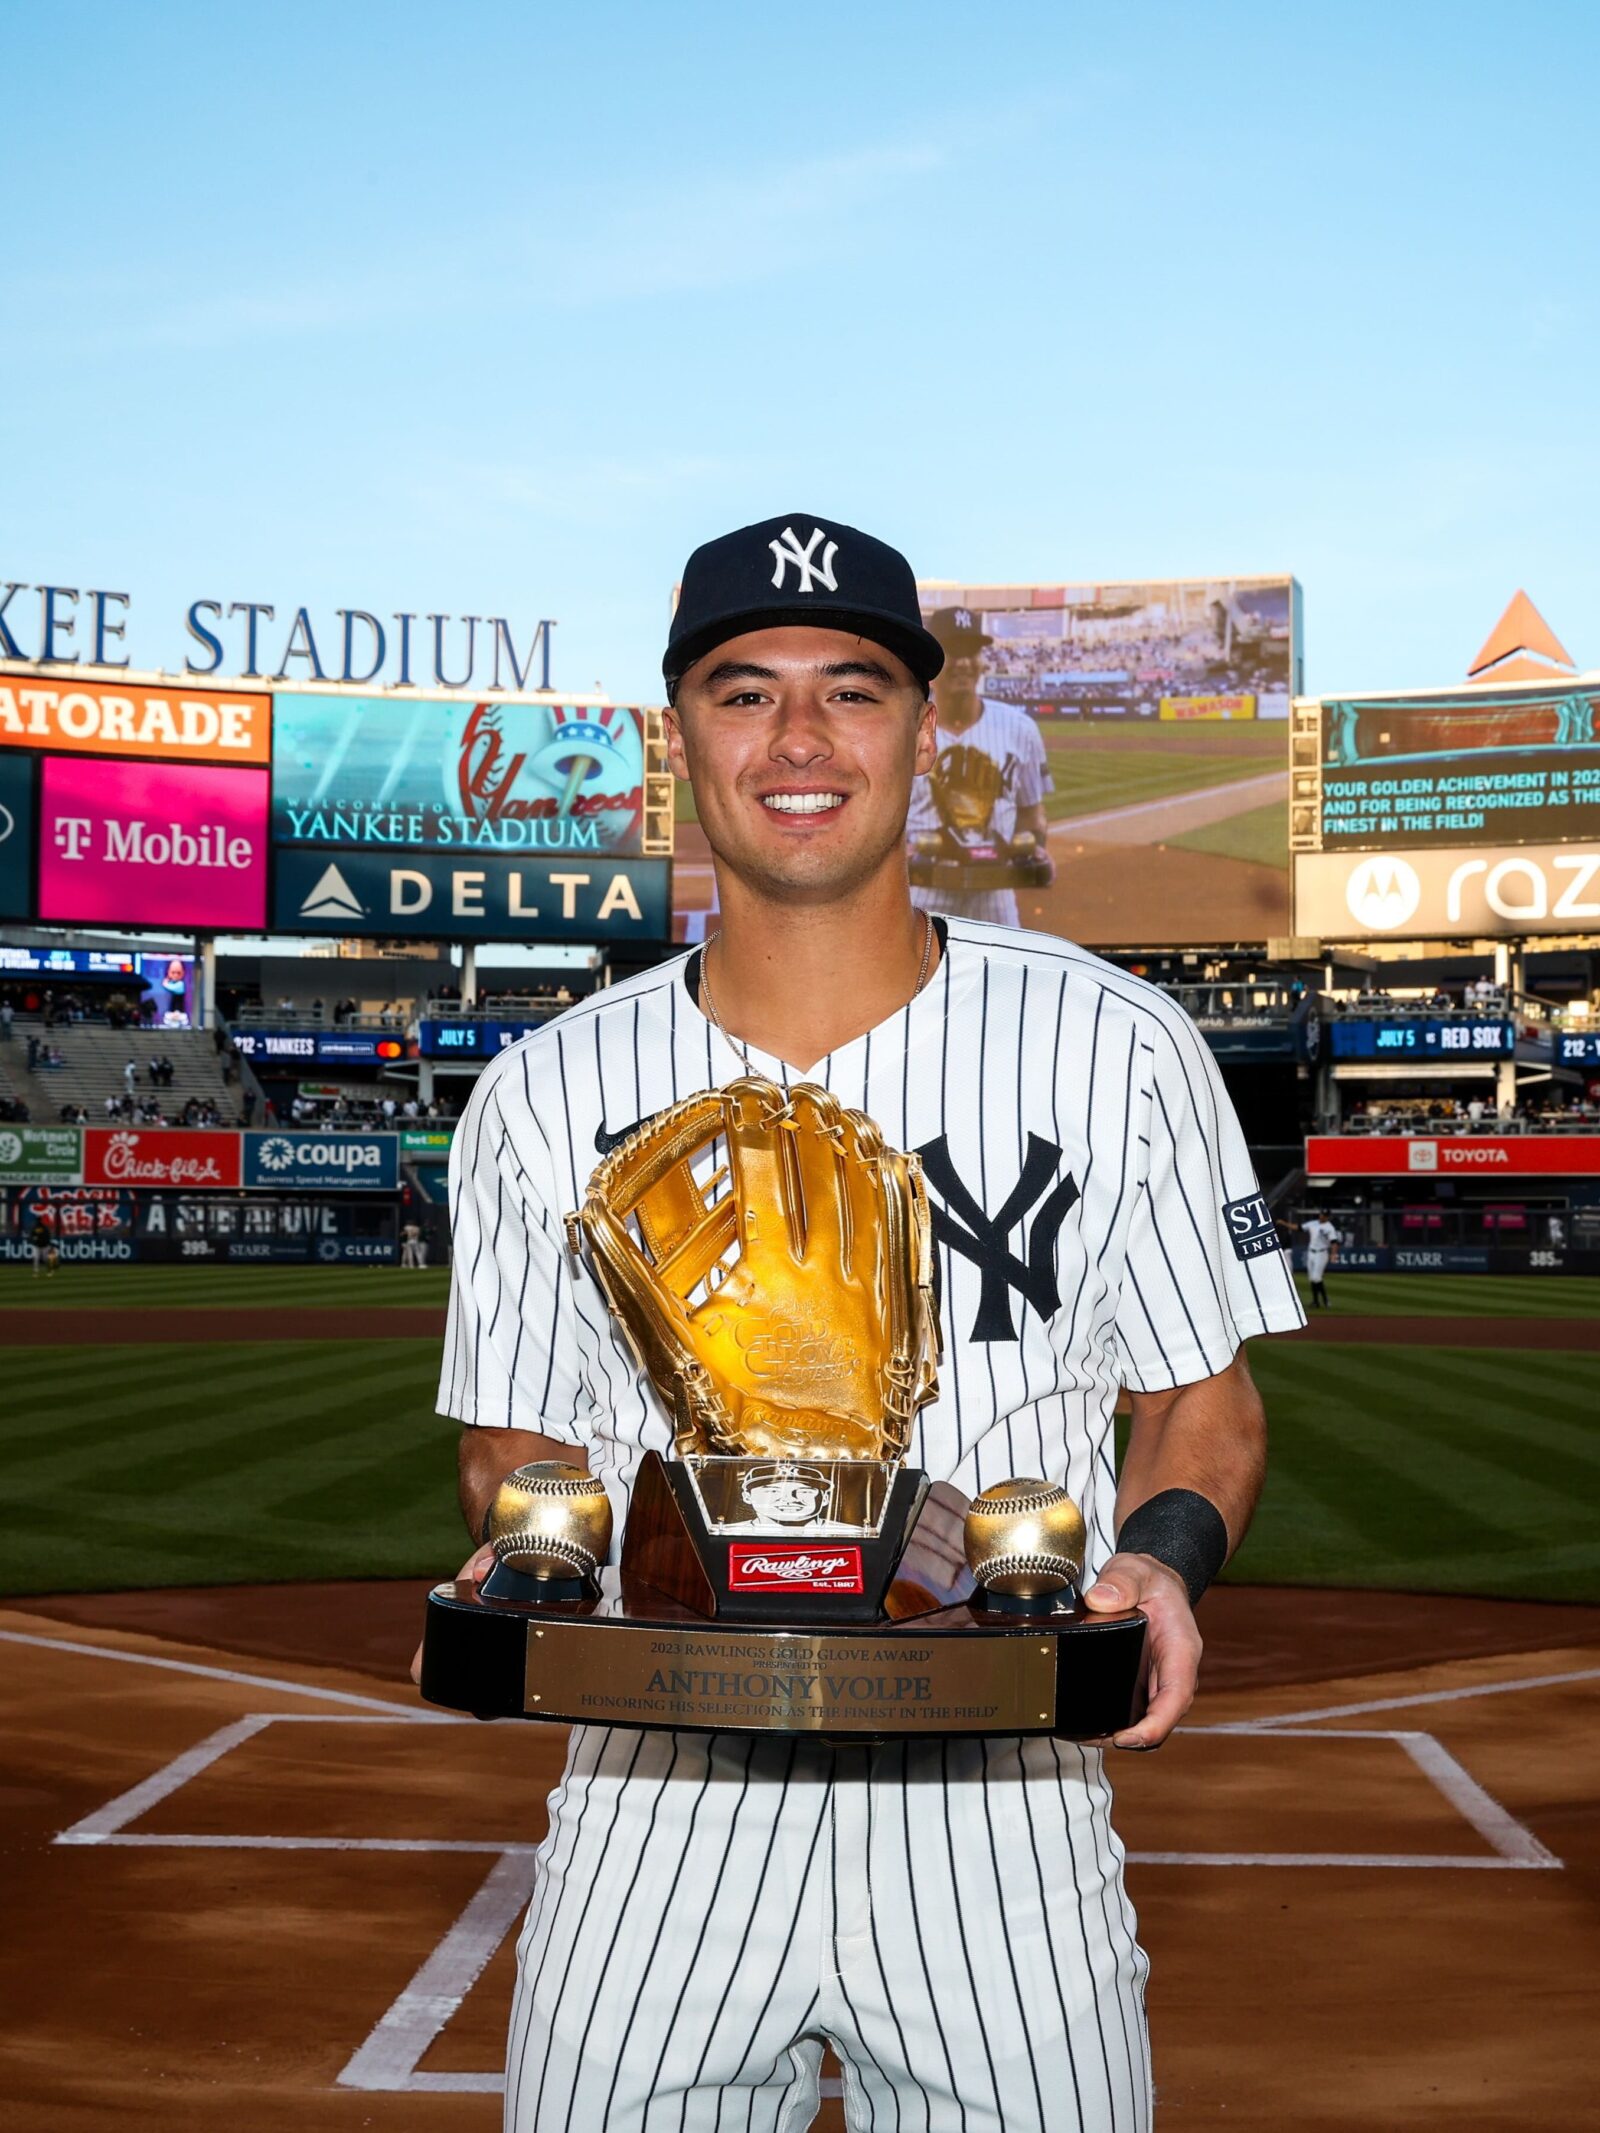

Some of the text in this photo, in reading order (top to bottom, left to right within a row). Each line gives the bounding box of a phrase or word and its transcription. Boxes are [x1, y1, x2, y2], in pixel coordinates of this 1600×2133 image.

[768, 526, 839, 592] NY
[184, 600, 557, 692] STADIUM
[1323, 782, 1367, 797] YOUR
[1370, 778, 1433, 796] GOLDEN
[1436, 772, 1548, 792] ACHIEVEMENT
[1551, 771, 1569, 787] IN
[287, 797, 444, 814] WELCOME TO
[1323, 800, 1357, 816] AND
[1360, 798, 1391, 814] FOR
[1395, 796, 1441, 813] BEING
[1445, 791, 1545, 810] RECOGNIZED
[1548, 790, 1570, 806] AS
[286, 810, 601, 848] YANKEE STADIUM
[1323, 812, 1484, 834] FINEST IN THE FIELD!
[103, 819, 253, 870] Mobile
[389, 868, 642, 920] DELTA
[1447, 854, 1600, 922] raz
[265, 1037, 315, 1055] YANKEES
[438, 1029, 465, 1046] JULY
[466, 1029, 475, 1046] 5
[1377, 1030, 1404, 1047] JULY
[1405, 1030, 1415, 1046] 5
[1441, 1027, 1470, 1048] RED
[1473, 1027, 1501, 1048] SOX
[297, 1144, 381, 1172] coupa
[1442, 1149, 1509, 1163] TOYOTA
[1230, 1198, 1272, 1234] ST
[345, 1245, 392, 1256] CLEAR
[1396, 1252, 1443, 1266] STARR
[741, 1555, 849, 1574] Rawlings
[650, 1641, 681, 1655] 2023
[685, 1644, 766, 1659] RAWLINGS
[769, 1647, 814, 1660] GOLD
[817, 1649, 870, 1661] GLOVE
[812, 1662, 827, 1671] TO
[645, 1668, 932, 1701] ANTHONY VOLPE
[581, 1694, 665, 1711] HONORING
[669, 1701, 695, 1713] HIS
[698, 1703, 783, 1717] SELECTION
[785, 1705, 805, 1718] AS
[808, 1705, 840, 1718] THE
[844, 1706, 897, 1719] FINEST
[900, 1706, 916, 1718] IN
[920, 1706, 950, 1719] THE
